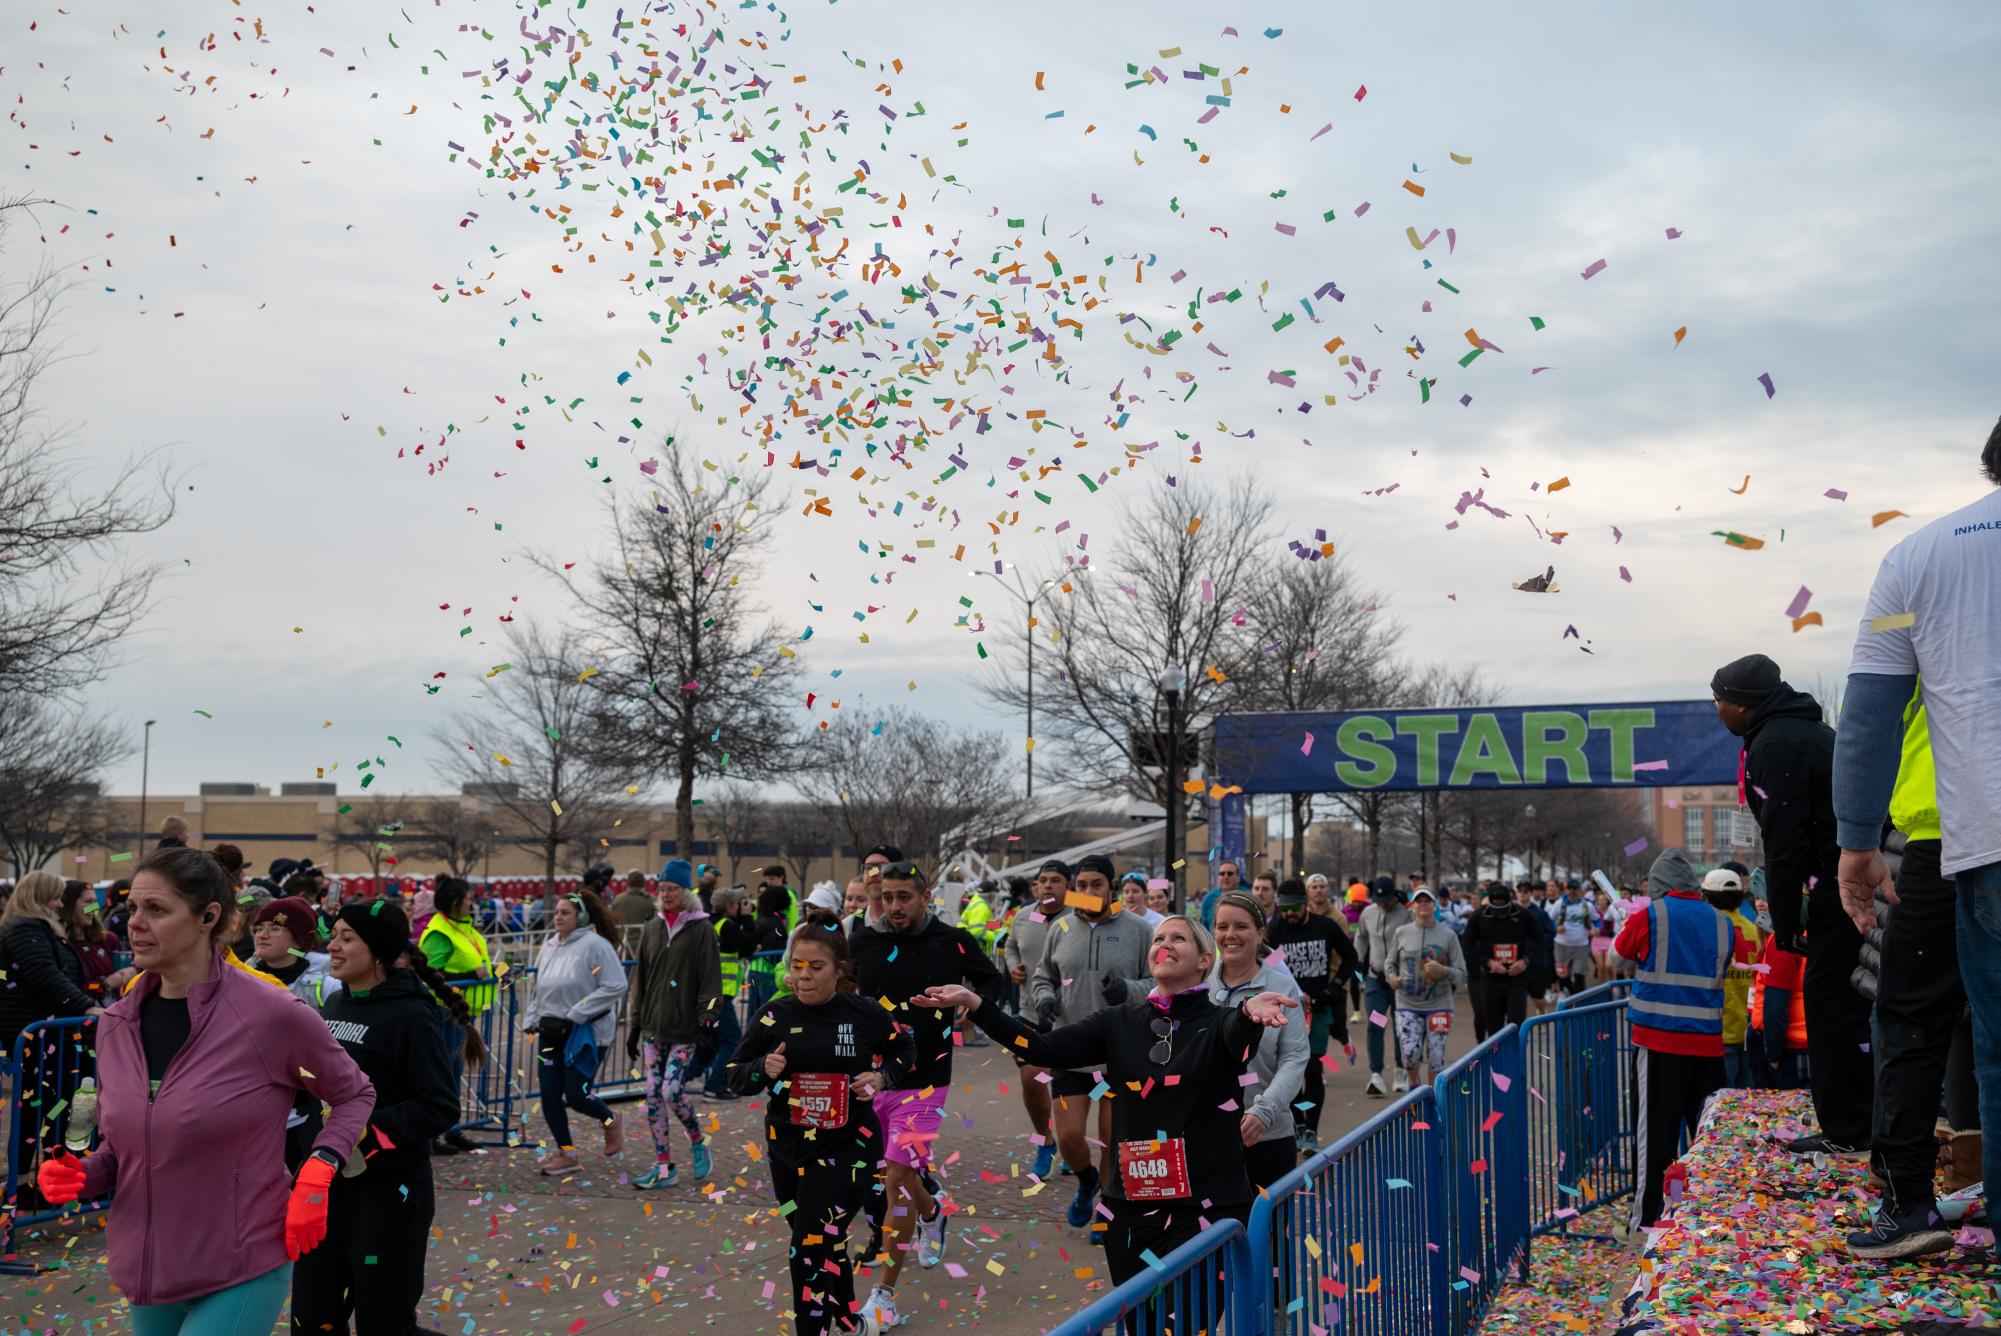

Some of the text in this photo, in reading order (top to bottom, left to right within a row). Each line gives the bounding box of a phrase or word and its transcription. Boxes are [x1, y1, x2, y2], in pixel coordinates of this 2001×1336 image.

[1955, 521, 2001, 536] INHALE
[1334, 708, 1656, 788] START
[1288, 960, 1327, 978] OPAMINE
[838, 1024, 853, 1034] OFF
[837, 1034, 854, 1045] THE
[835, 1045, 856, 1057] WALL
[1173, 1139, 1178, 1149] 7
[1128, 1158, 1168, 1179] 4648
[1179, 1182, 1184, 1192] 7
